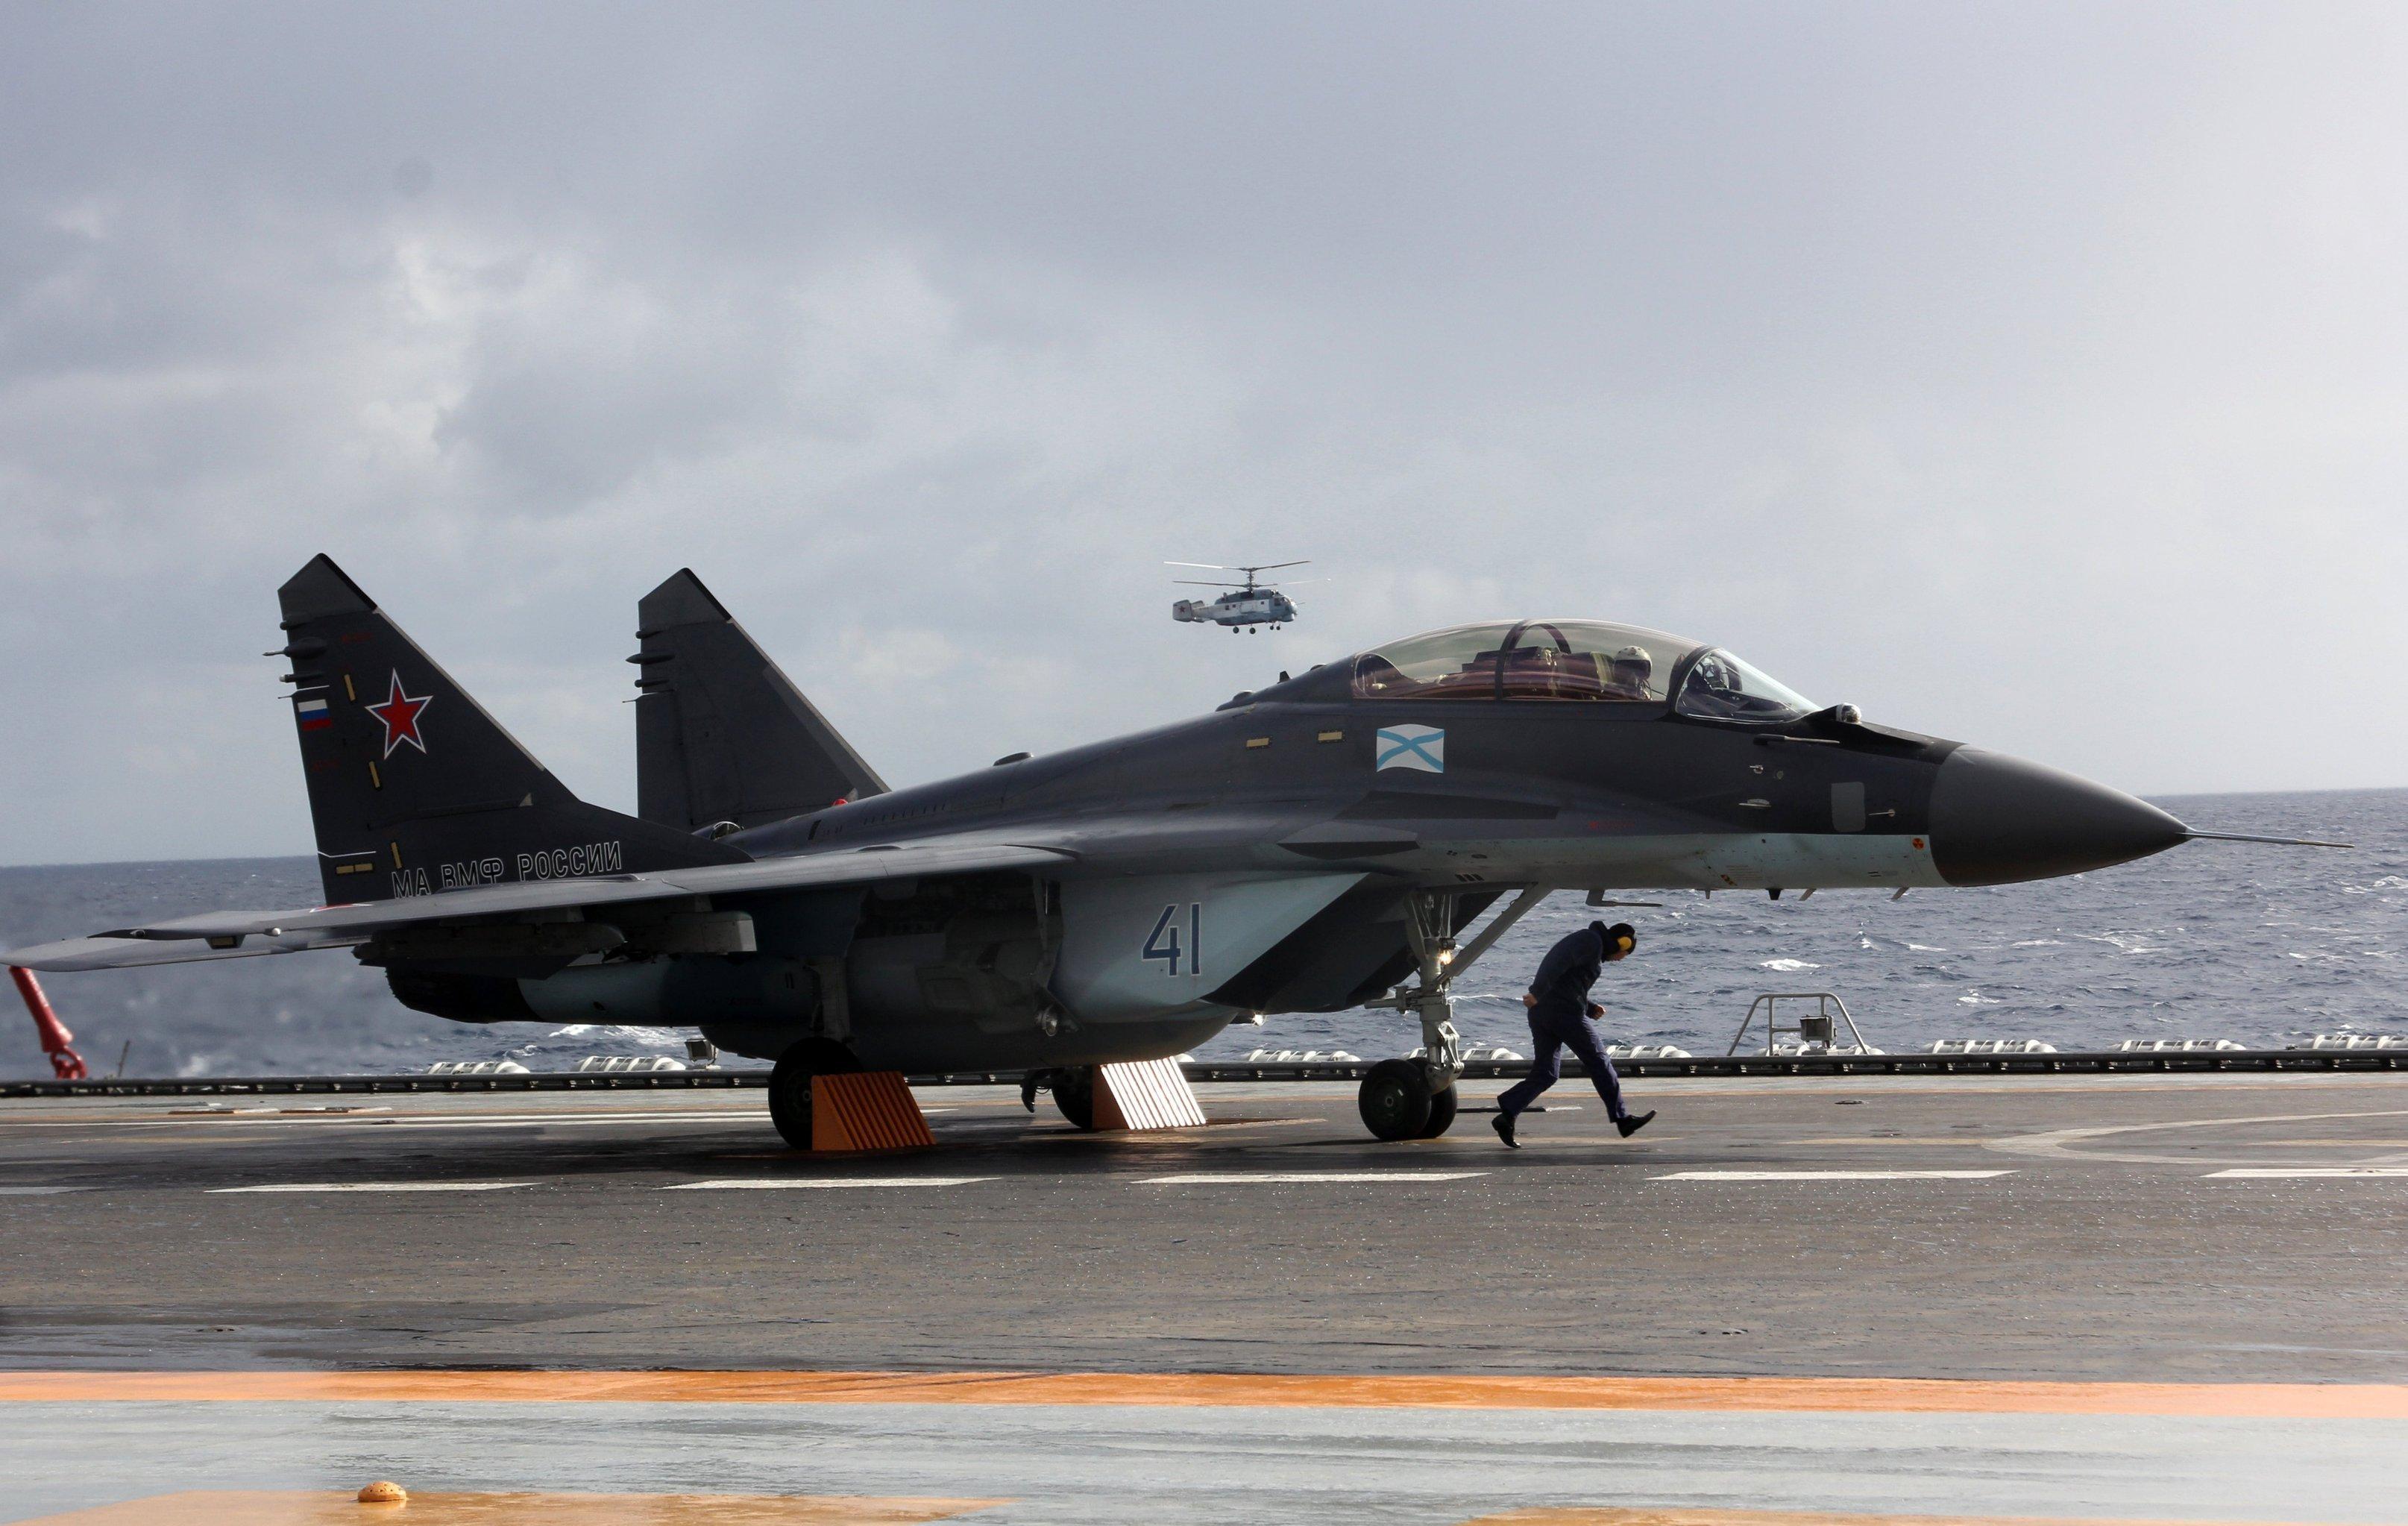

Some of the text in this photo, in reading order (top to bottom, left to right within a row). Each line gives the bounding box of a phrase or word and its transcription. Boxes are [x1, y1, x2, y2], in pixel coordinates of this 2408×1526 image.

[392, 841, 622, 899] МА ВМФ РОССИИ
[1142, 902, 1201, 977] 41
